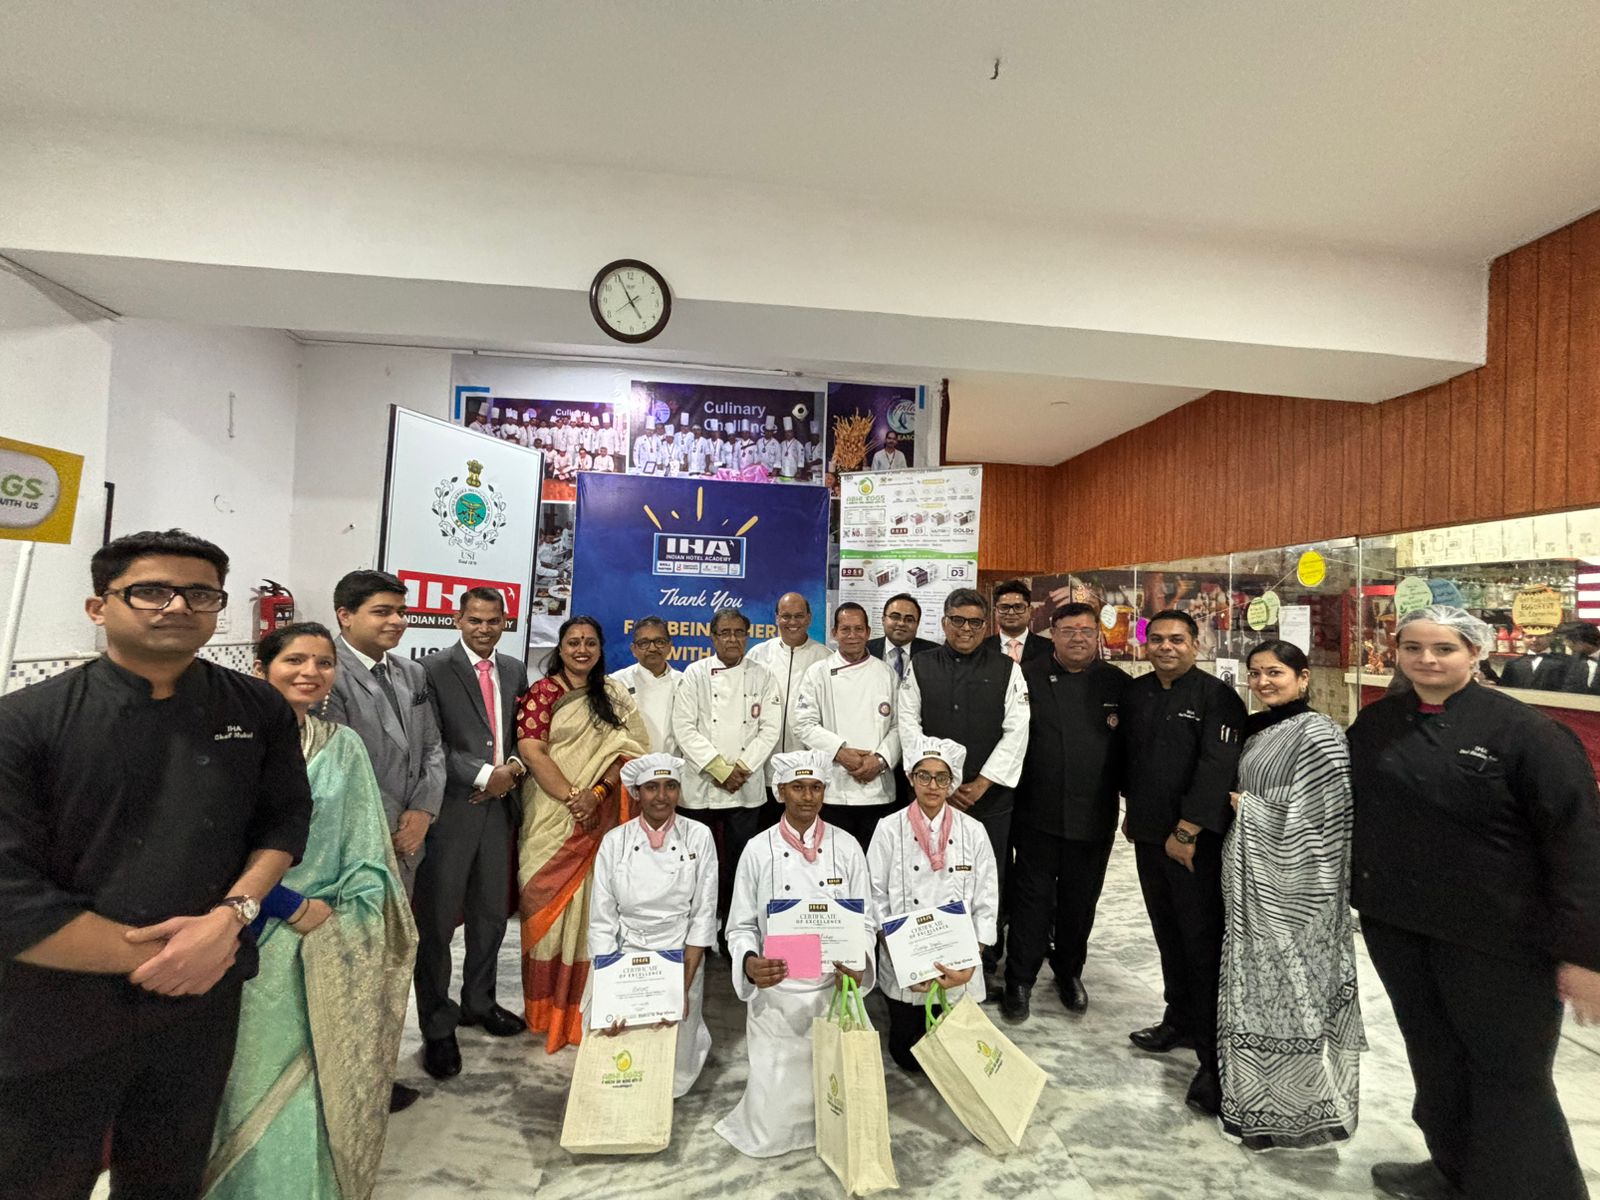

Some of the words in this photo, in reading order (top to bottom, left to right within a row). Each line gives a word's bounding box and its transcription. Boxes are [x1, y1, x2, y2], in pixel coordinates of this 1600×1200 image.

[704, 401, 766, 418] Culinary
[25, 502, 39, 510] US
[666, 537, 731, 556] IHA
[951, 569, 964, 578] D3
[658, 587, 707, 607] Thank
[710, 590, 744, 613] You
[403, 614, 436, 625] NDIAN
[667, 620, 712, 637] BEIN
